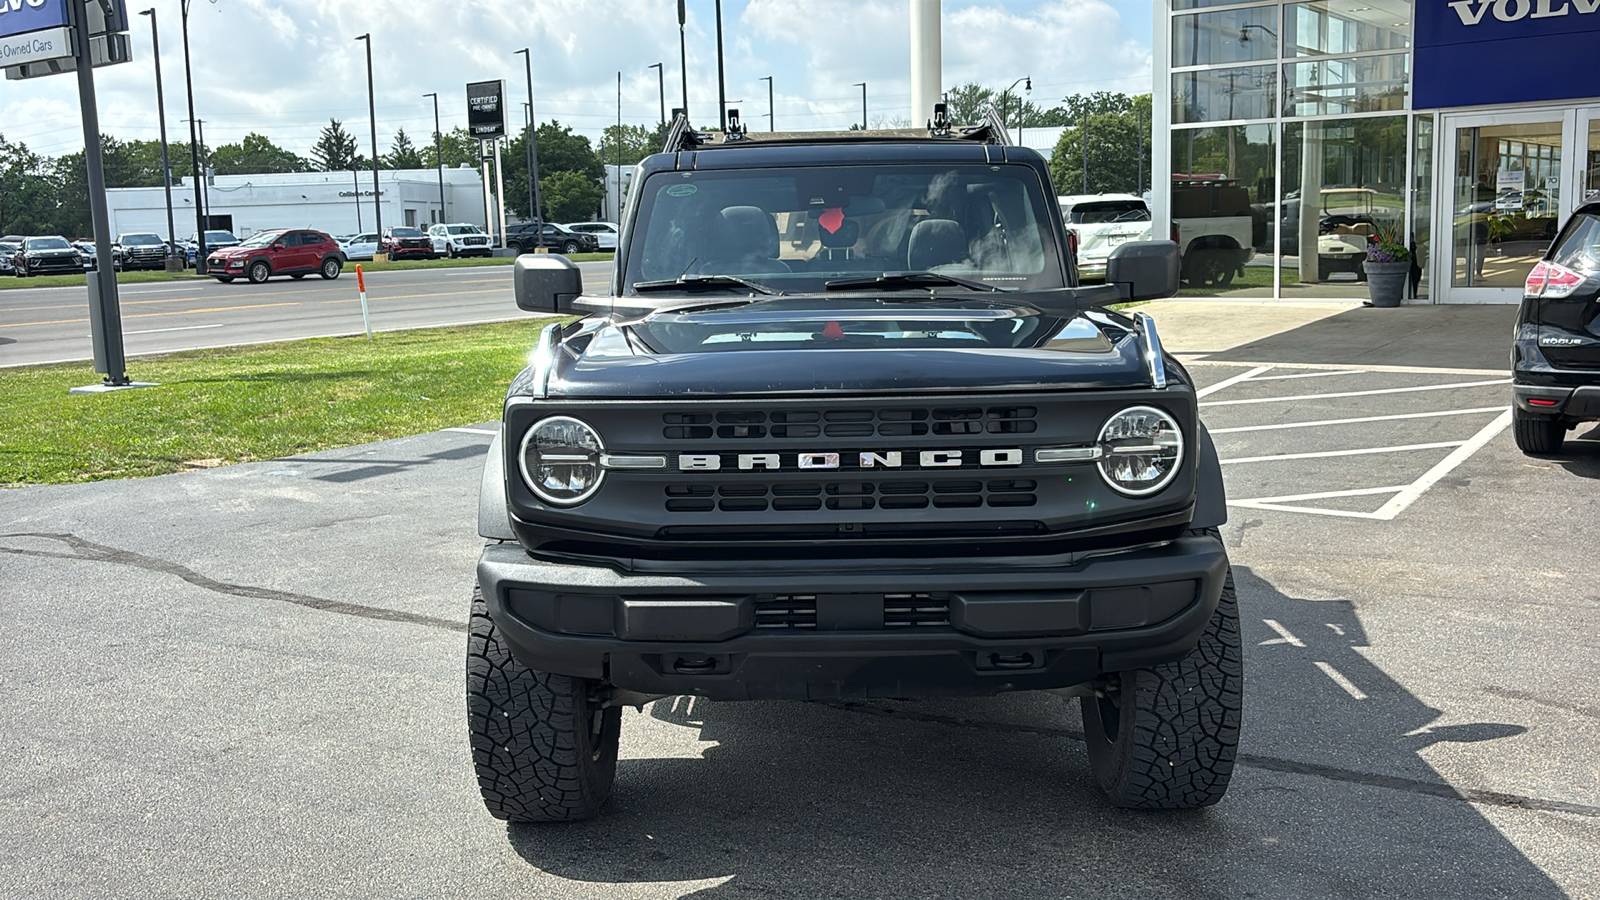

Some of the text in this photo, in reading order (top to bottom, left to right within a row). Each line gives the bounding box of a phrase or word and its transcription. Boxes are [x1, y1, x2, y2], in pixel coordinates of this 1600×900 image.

[3, 41, 31, 57] Owned
[33, 39, 53, 52] Cars
[470, 95, 498, 105] CERTIFIED
[1542, 337, 1582, 345] ROGUE
[678, 448, 1023, 470] BRONCO
